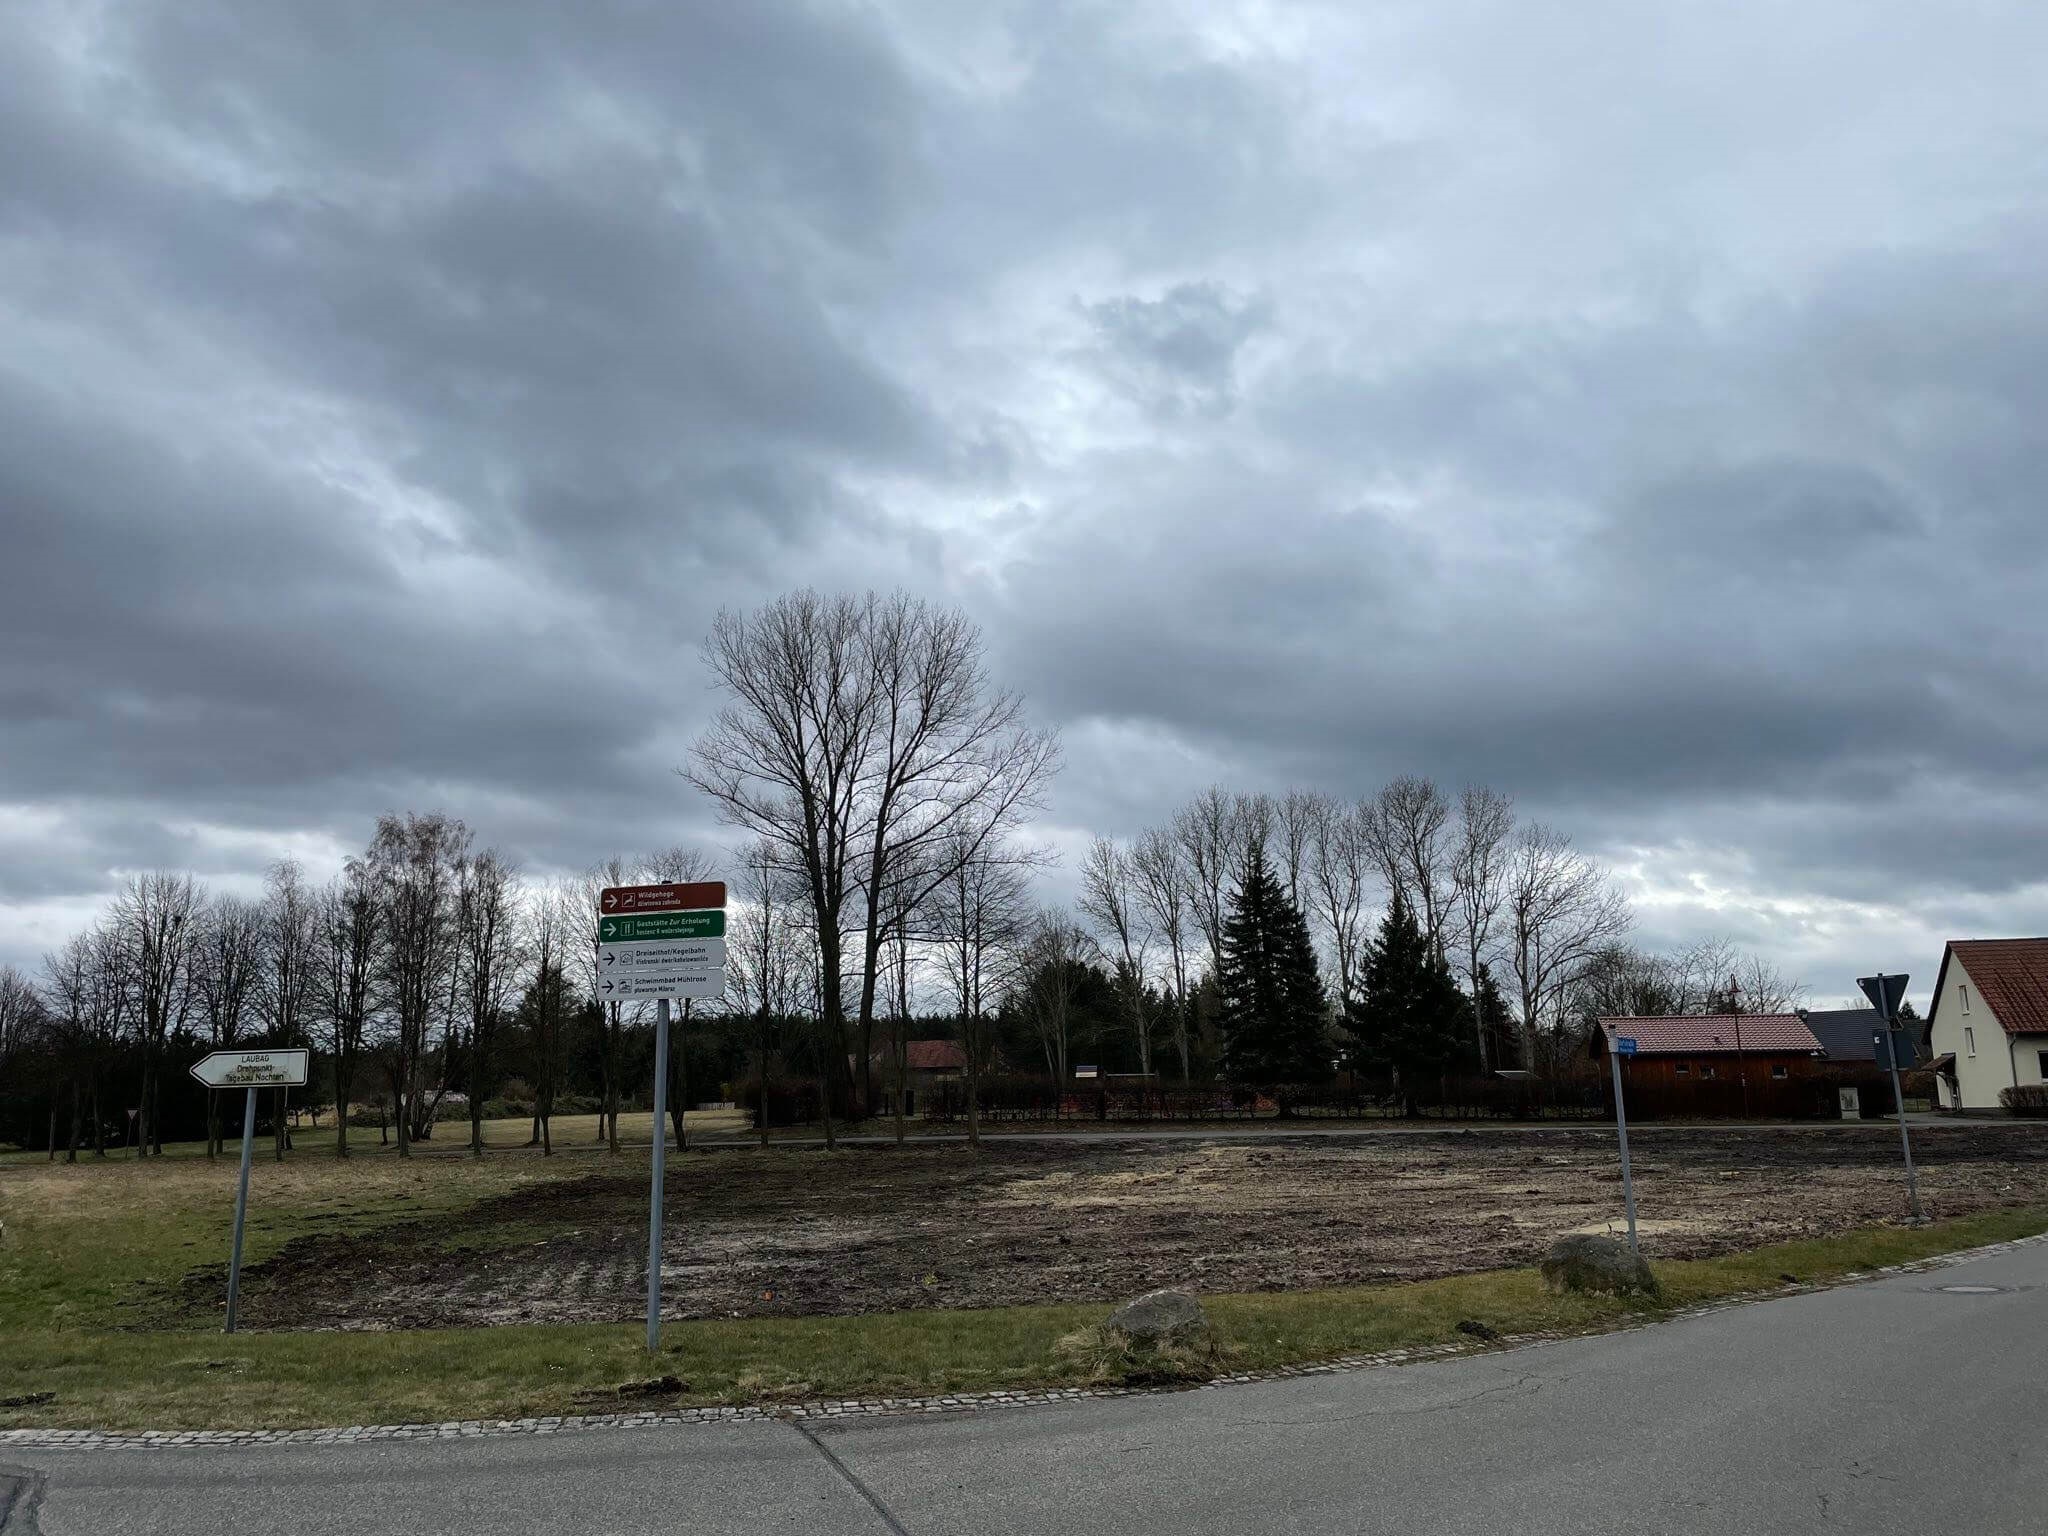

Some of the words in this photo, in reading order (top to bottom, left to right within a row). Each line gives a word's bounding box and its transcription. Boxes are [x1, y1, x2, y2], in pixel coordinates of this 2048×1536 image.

[636, 919, 668, 927] Gaststätte
[669, 918, 681, 926] Zur
[681, 917, 710, 926] Erholung
[634, 977, 676, 985] Schwimmbad
[225, 1074, 253, 1083] Tagebau
